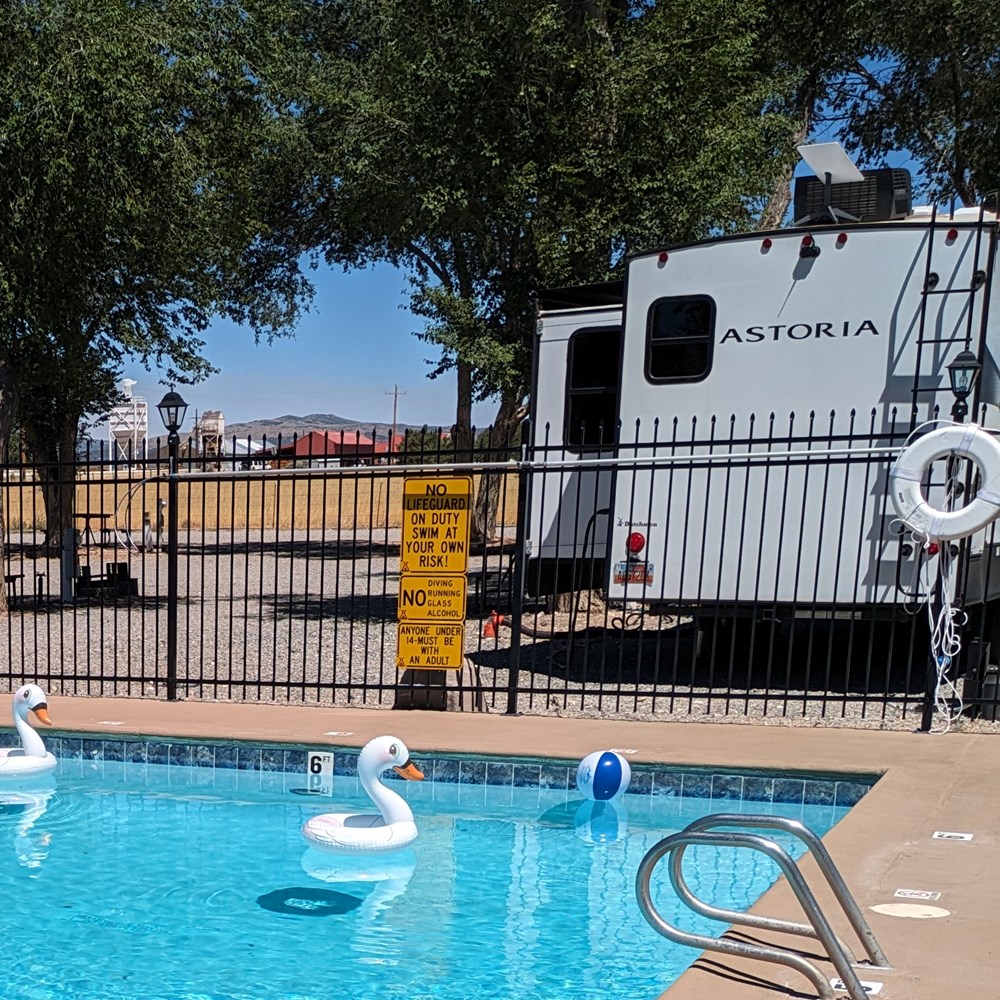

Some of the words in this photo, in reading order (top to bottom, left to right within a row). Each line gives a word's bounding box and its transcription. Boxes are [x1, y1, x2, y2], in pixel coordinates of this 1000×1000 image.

[719, 320, 880, 344] ASTORIA
[426, 484, 447, 496] NO
[407, 498, 465, 510] LIFEGUARD
[411, 512, 425, 525] ON
[432, 512, 460, 525] DUTY
[412, 527, 438, 539] SWIM
[445, 527, 458, 539] AT
[406, 541, 434, 553] YOUR
[441, 541, 464, 553] OWN
[419, 555, 448, 567] RISK!
[403, 589, 426, 606] NO
[401, 626, 429, 635] ANYONE
[435, 627, 461, 636] UNDER
[406, 636, 438, 645] 14-MUST
[444, 637, 454, 646] BE
[421, 646, 439, 655] WITH
[410, 656, 420, 664] AN
[426, 656, 449, 665] ADULT
[310, 755, 322, 774] 6
